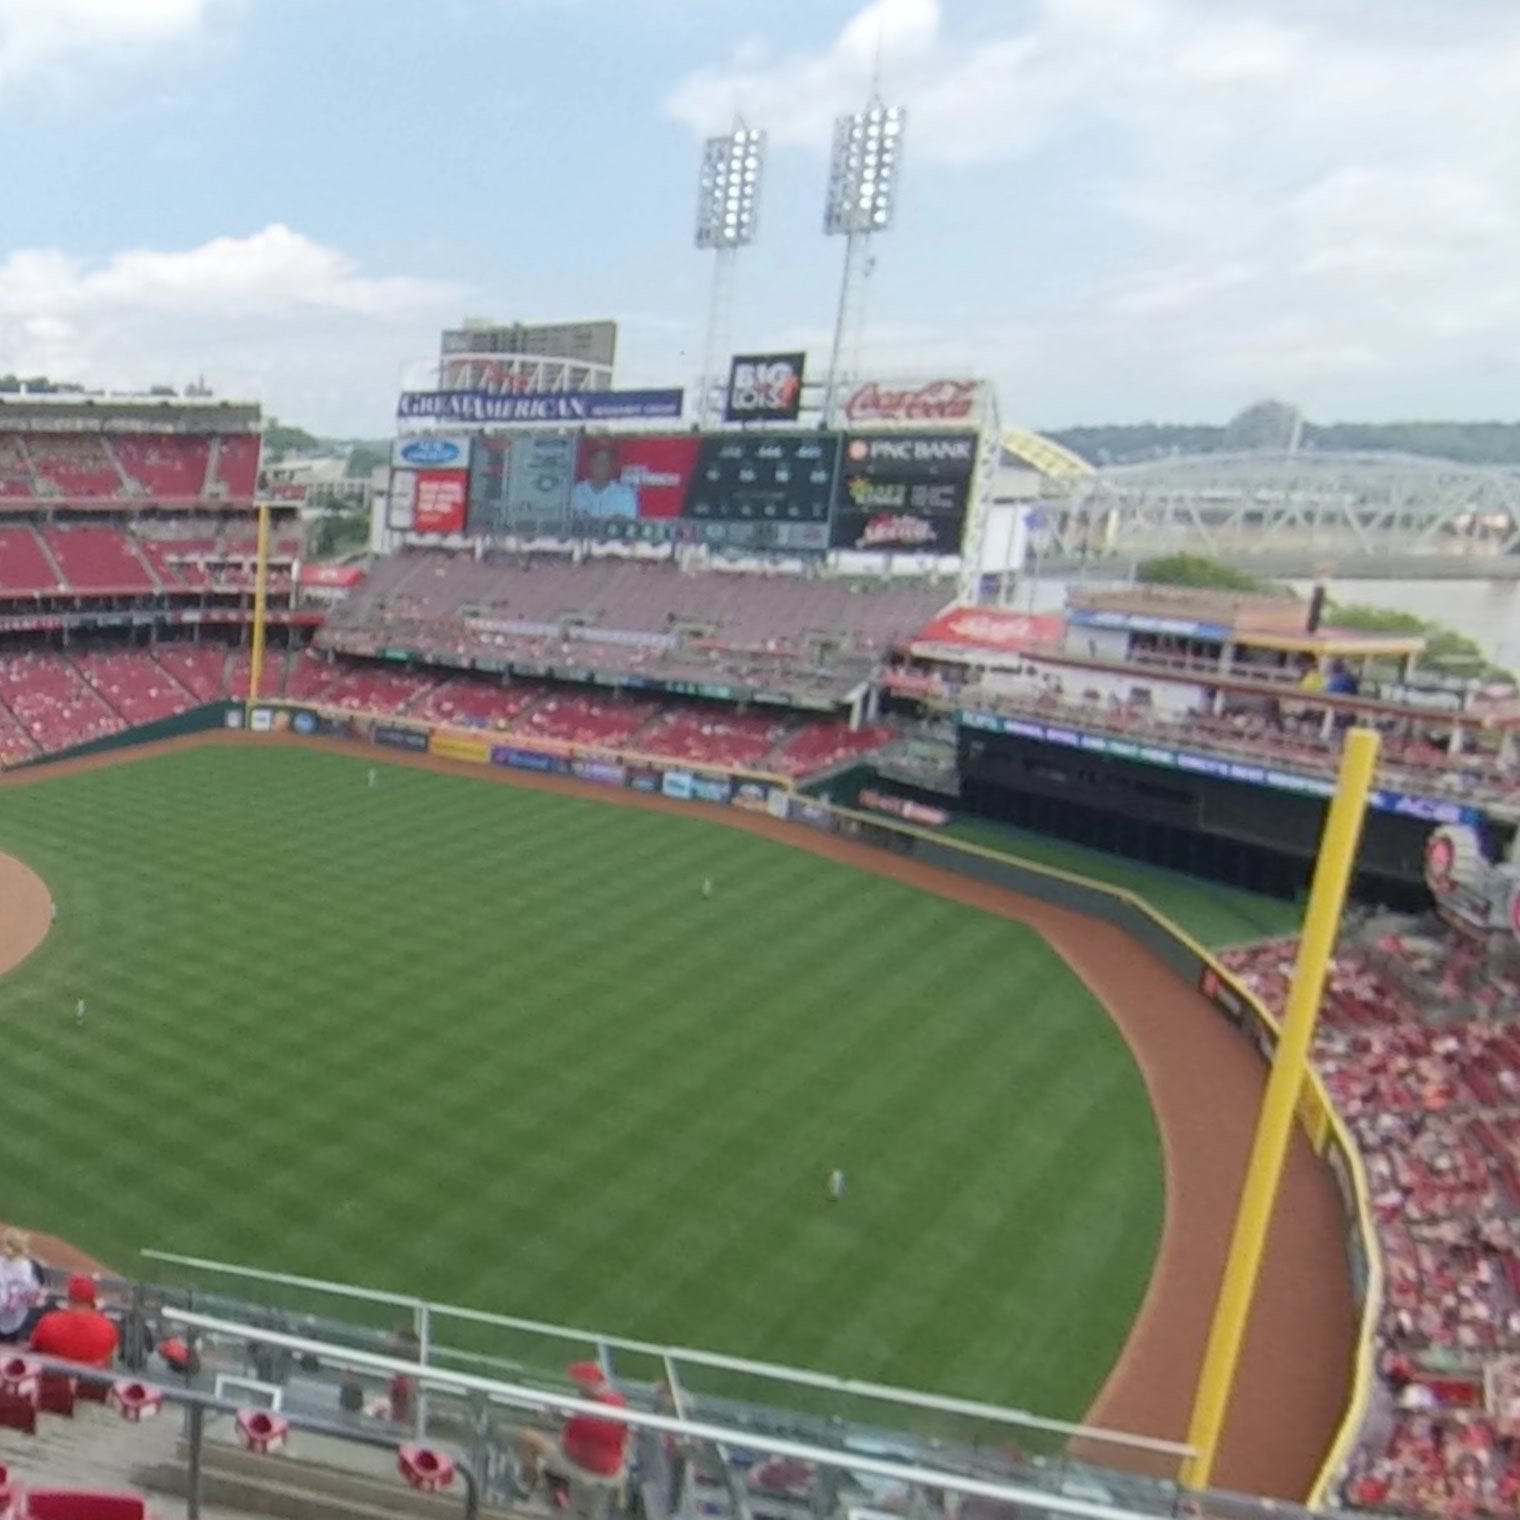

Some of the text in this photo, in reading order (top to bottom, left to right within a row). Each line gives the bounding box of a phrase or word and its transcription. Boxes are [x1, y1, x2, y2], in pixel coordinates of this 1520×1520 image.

[735, 362, 794, 388] BIG
[467, 396, 585, 419] AMERICAN
[845, 380, 977, 419] Coca-Cola
[871, 440, 971, 460] PNC BANK
